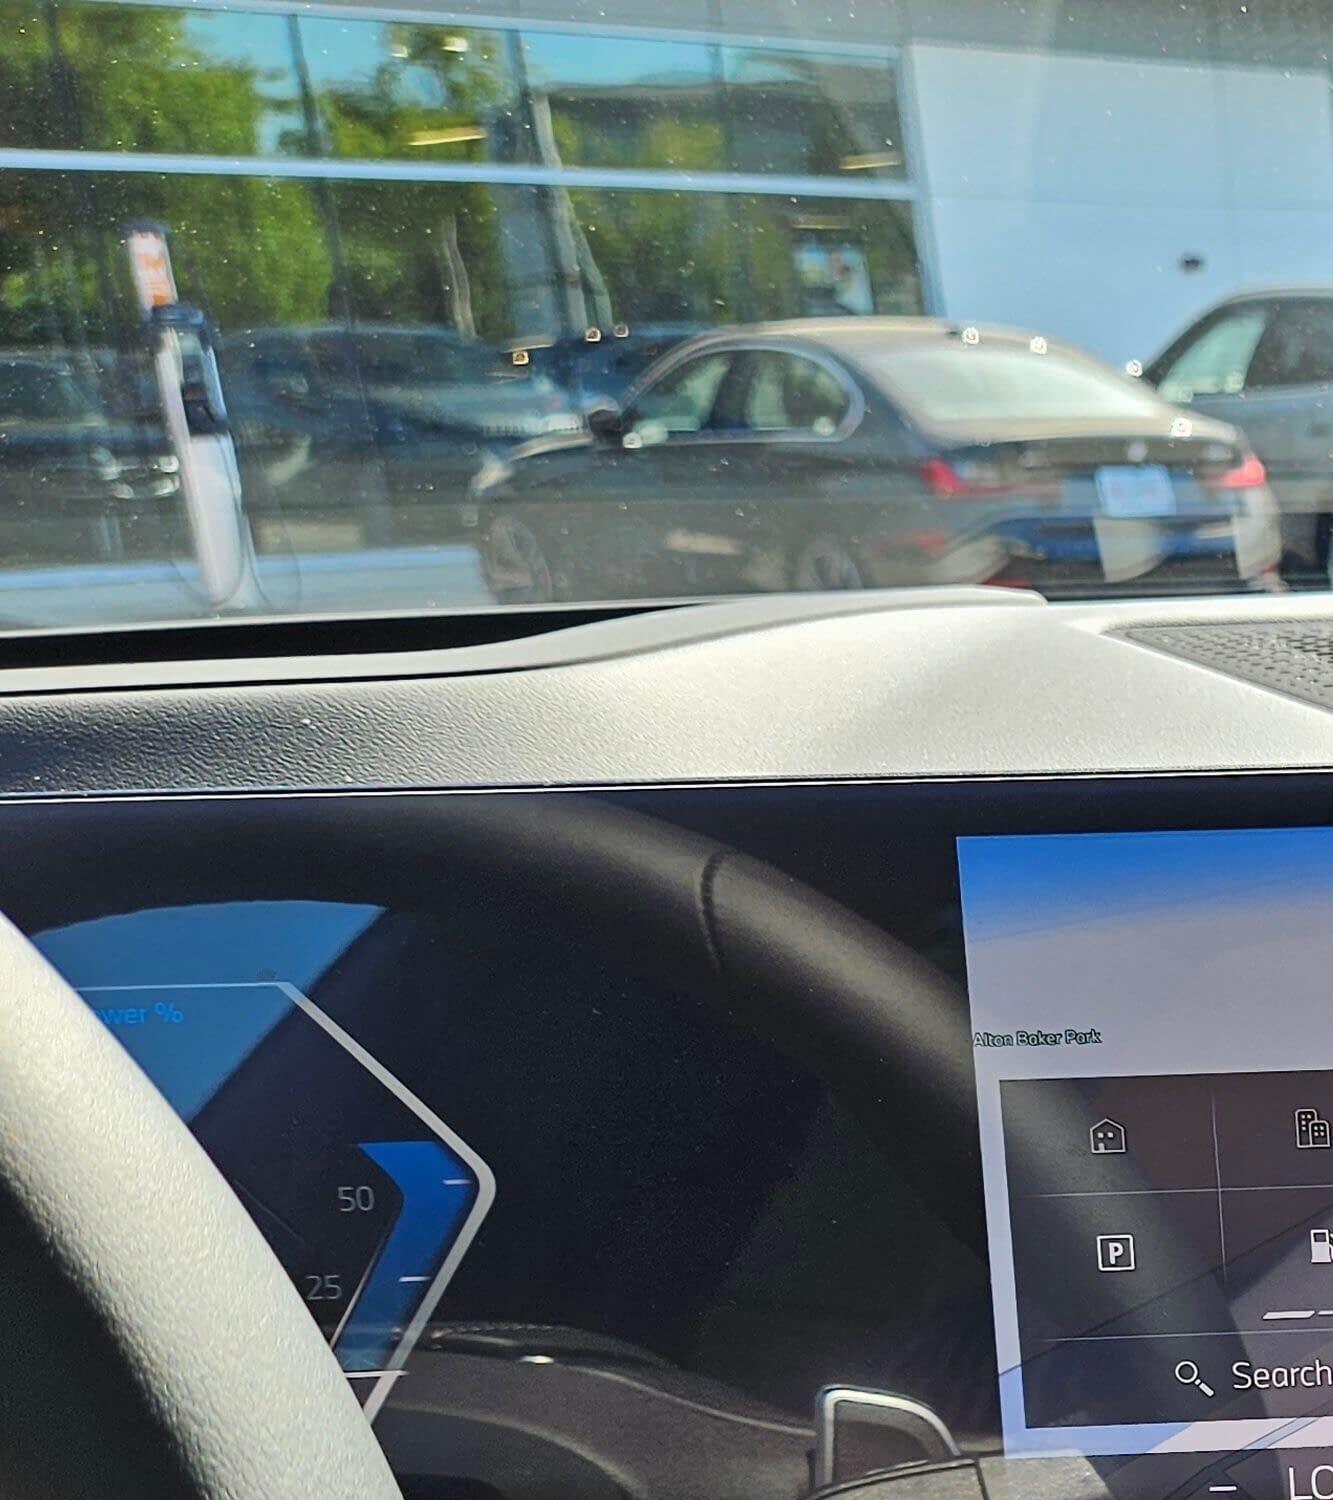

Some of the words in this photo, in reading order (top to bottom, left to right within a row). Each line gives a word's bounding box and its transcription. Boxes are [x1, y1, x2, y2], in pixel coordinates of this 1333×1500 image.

[96, 1007, 147, 1024] wer
[974, 1032, 1013, 1047] Alton
[1016, 1030, 1063, 1046] Baker
[1065, 1028, 1102, 1044] Park
[337, 1186, 375, 1212] 50
[306, 1274, 342, 1300] 25
[1231, 1360, 1333, 1389] Search
